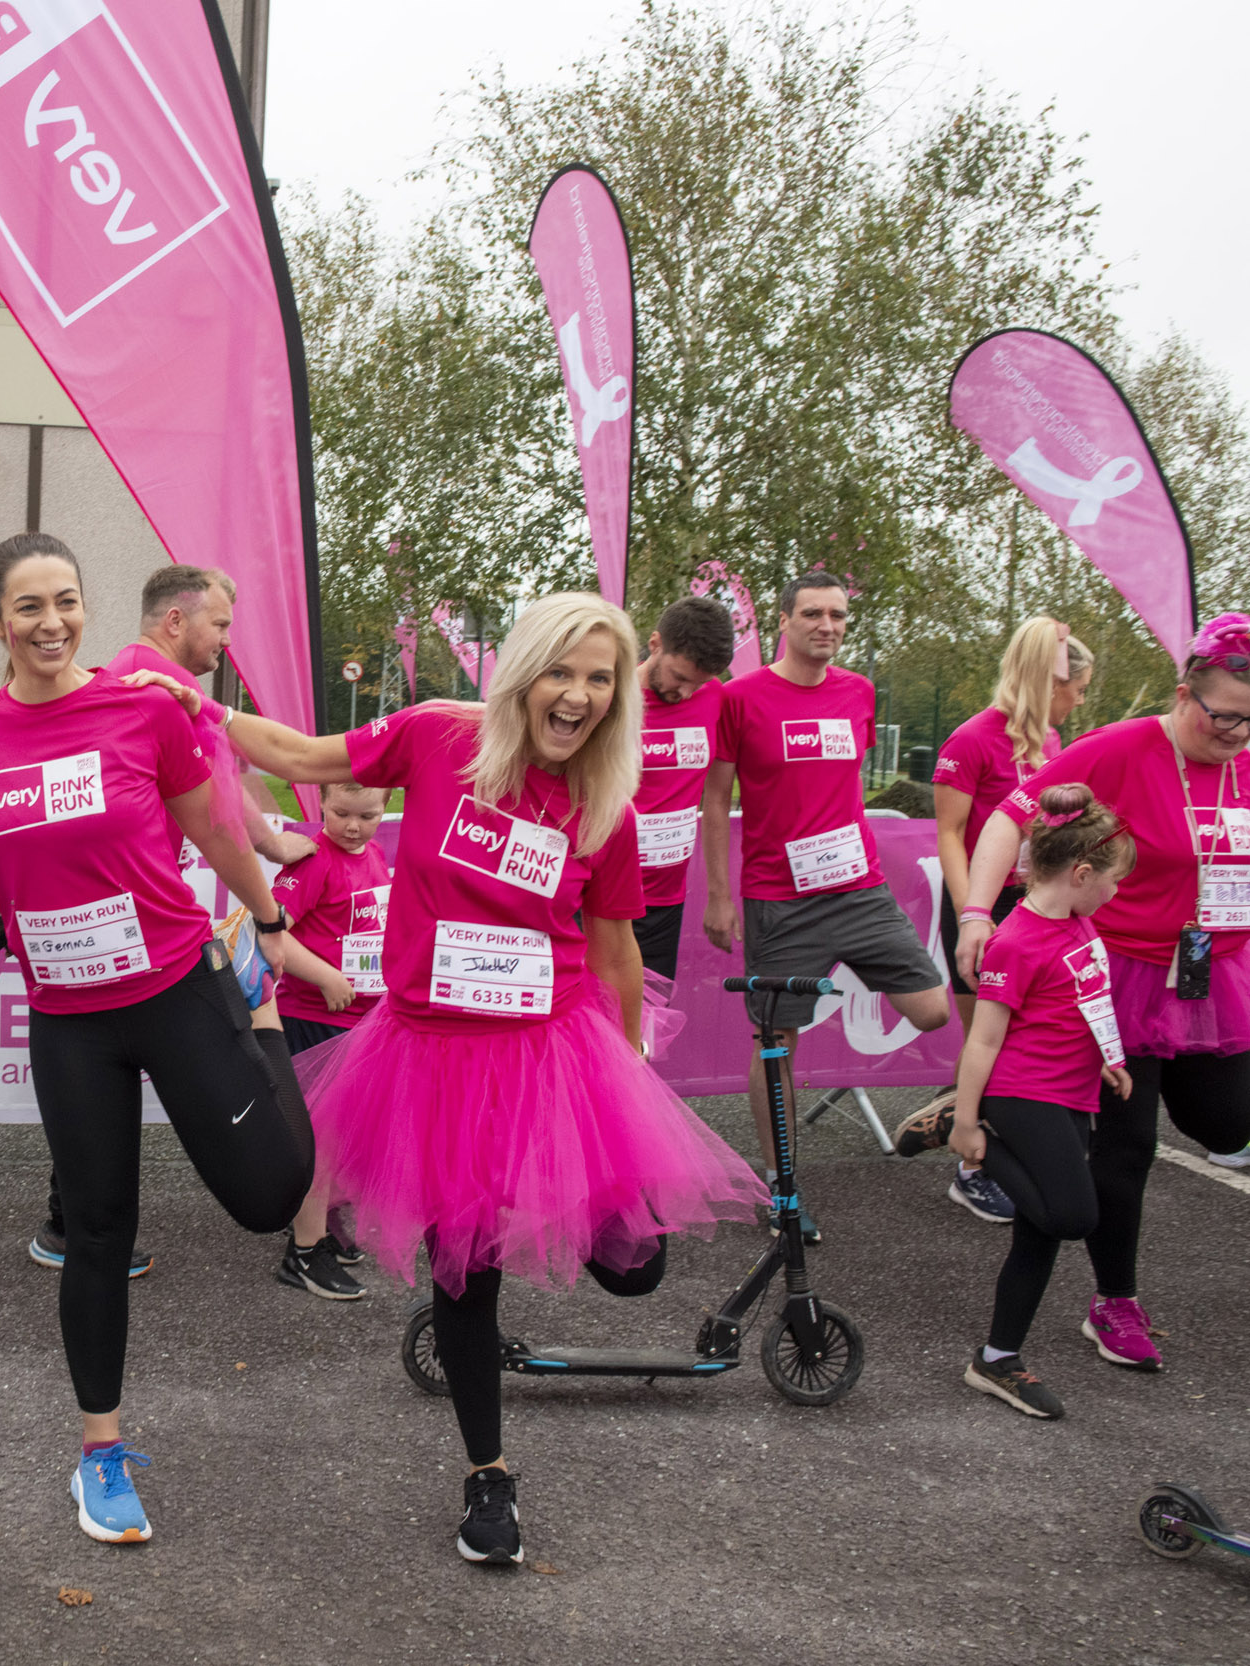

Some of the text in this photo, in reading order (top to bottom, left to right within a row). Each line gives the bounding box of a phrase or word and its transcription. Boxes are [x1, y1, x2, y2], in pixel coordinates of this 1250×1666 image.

[787, 733, 852, 747] very PINK
[642, 742, 707, 757] very PINK
[825, 744, 851, 754] RUN
[680, 754, 704, 764] RUN
[50, 774, 96, 797] PINK
[51, 791, 94, 815] RUN
[457, 818, 507, 853] very
[511, 841, 560, 872] PINK
[505, 859, 550, 888] RUN
[25, 902, 127, 928] VERY PINK RUN
[350, 940, 374, 948] VERY
[447, 928, 545, 949] VERY PINK RUN
[68, 962, 106, 979] 1189
[472, 989, 513, 1006] 6335
